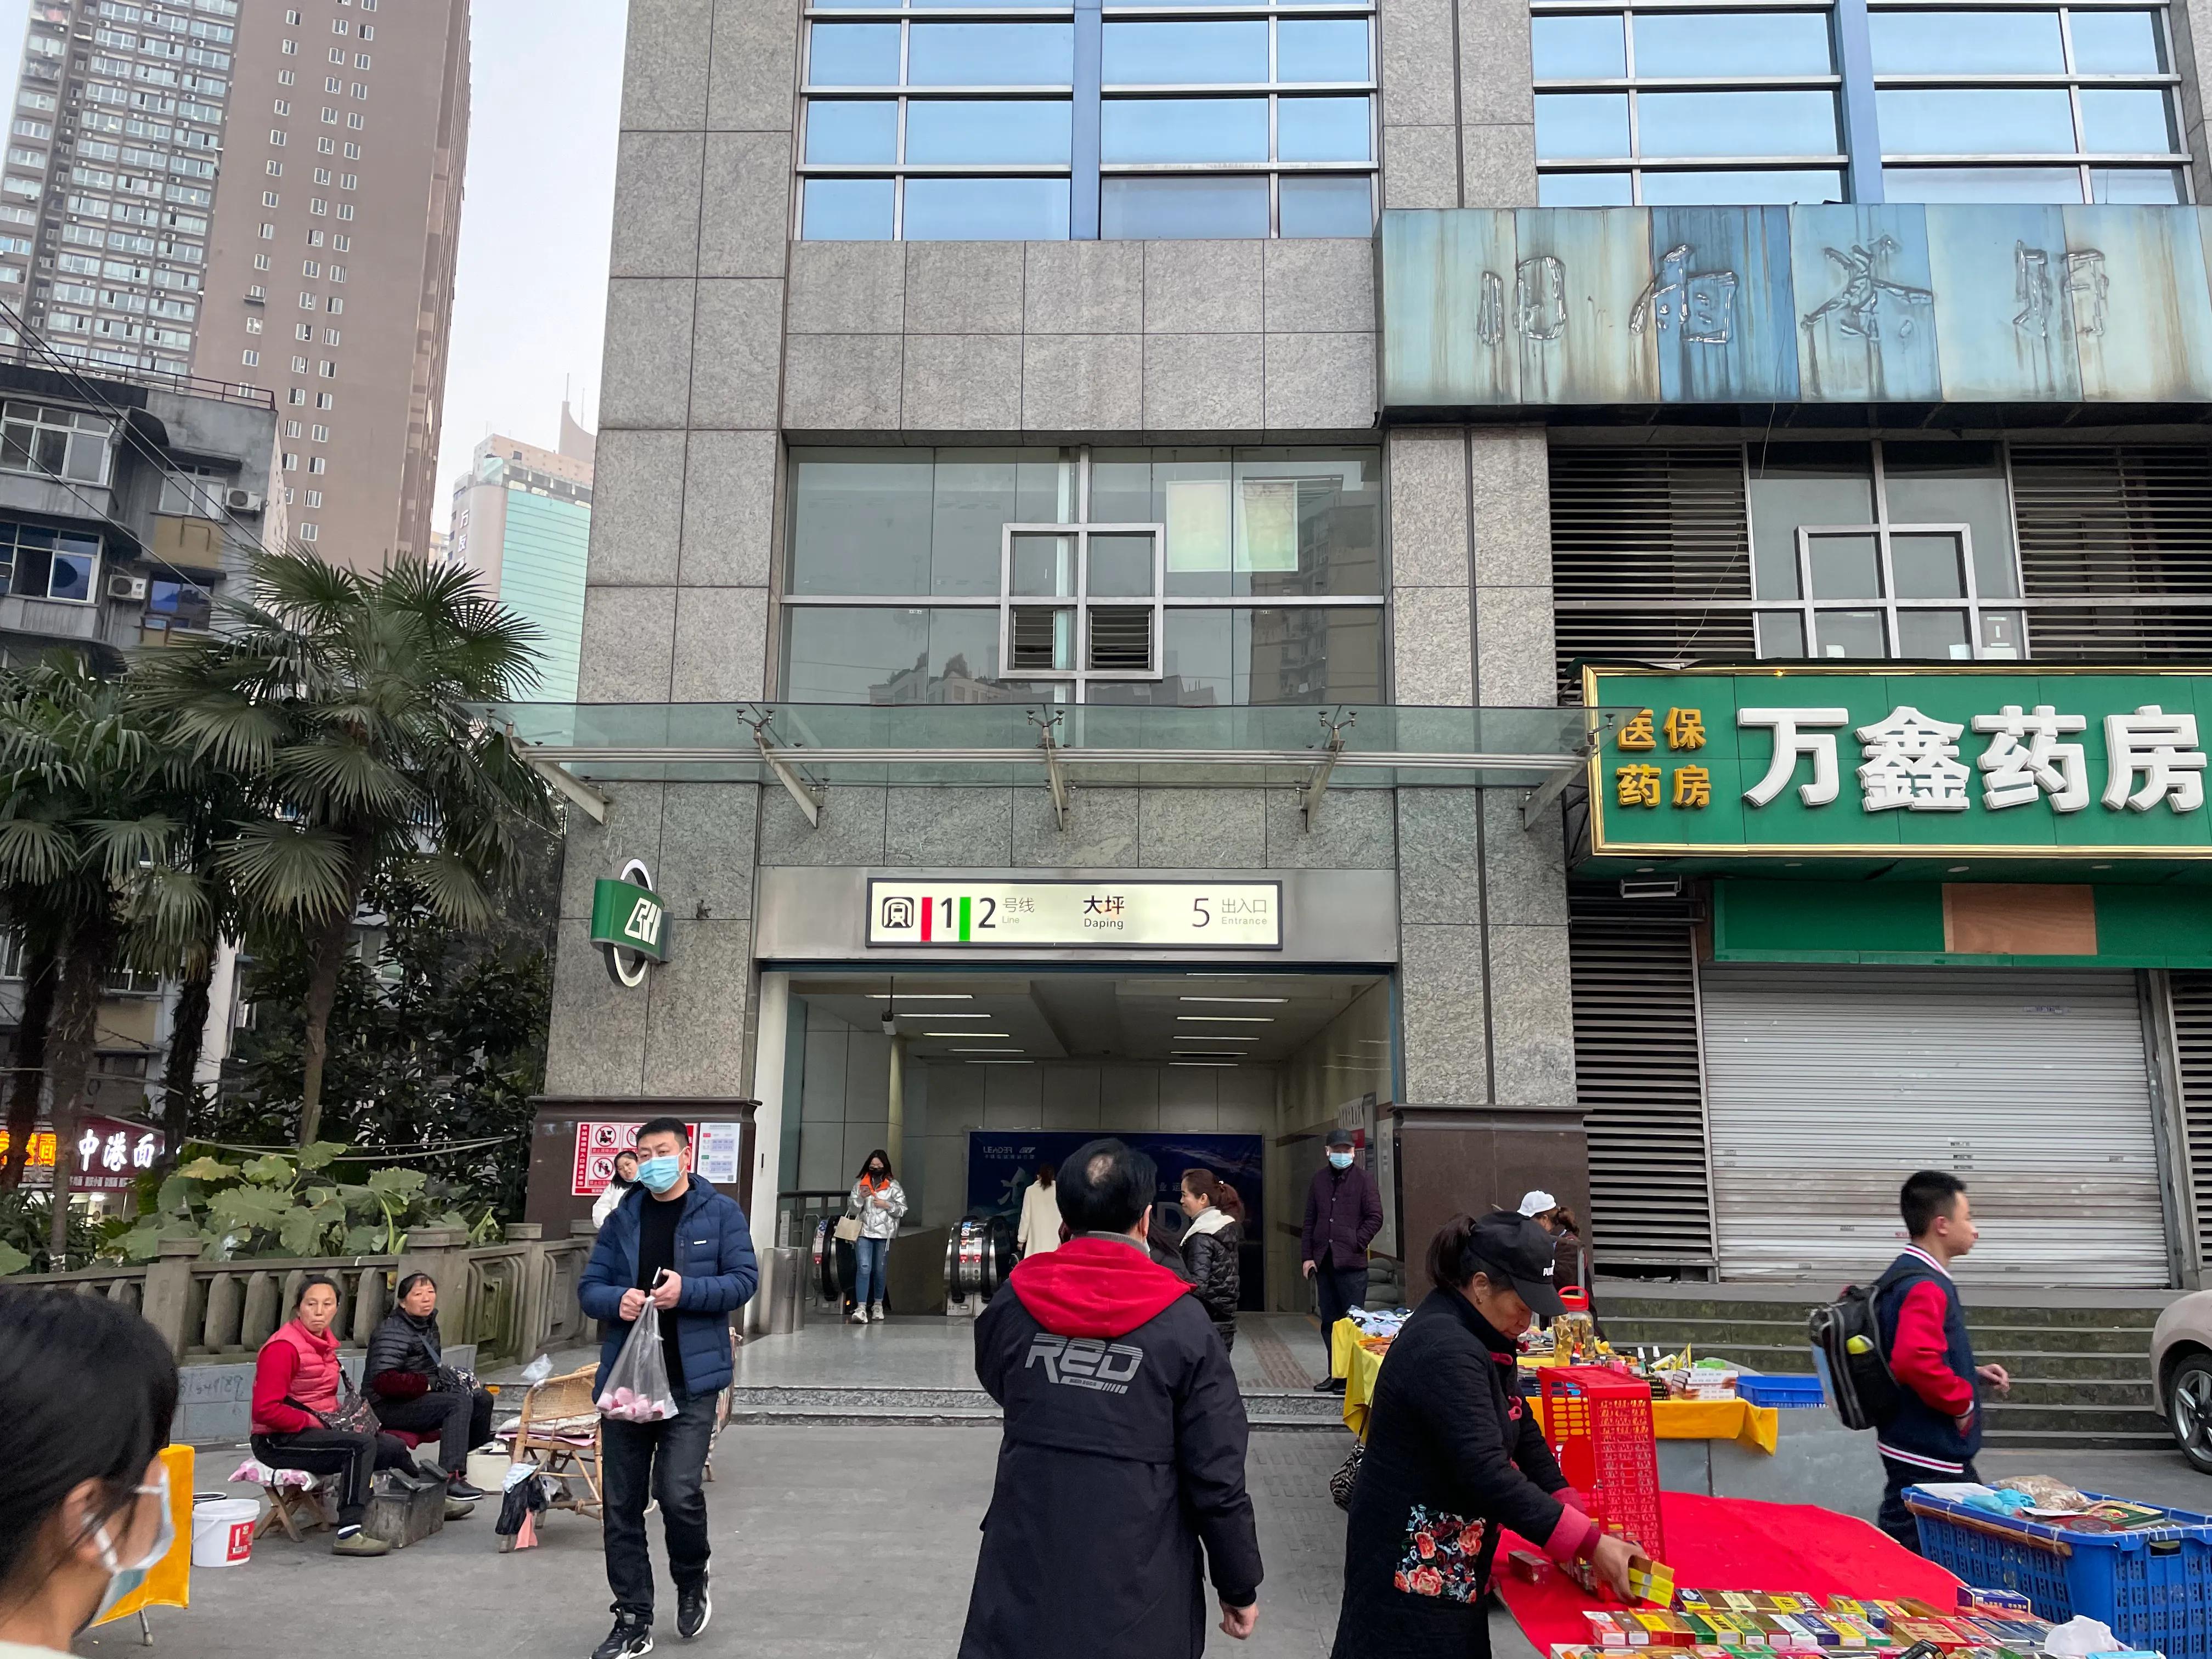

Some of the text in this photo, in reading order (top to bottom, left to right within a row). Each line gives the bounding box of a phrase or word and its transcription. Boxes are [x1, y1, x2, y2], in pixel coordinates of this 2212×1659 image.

[1617, 707, 1707, 751] 医保
[1737, 704, 2208, 814] 万鑫药房
[1615, 764, 1712, 808] 药房
[940, 897, 952, 928] 1
[978, 897, 1035, 928] 2 号线
[1002, 916, 1020, 924] Line
[1083, 895, 1125, 915] 大坪
[1192, 898, 1267, 928] 5 出入口
[1221, 916, 1267, 925] Entrance
[1084, 918, 1124, 930] Daping
[78, 1128, 165, 1172] 中港面
[1024, 1333, 1143, 1384] RED
